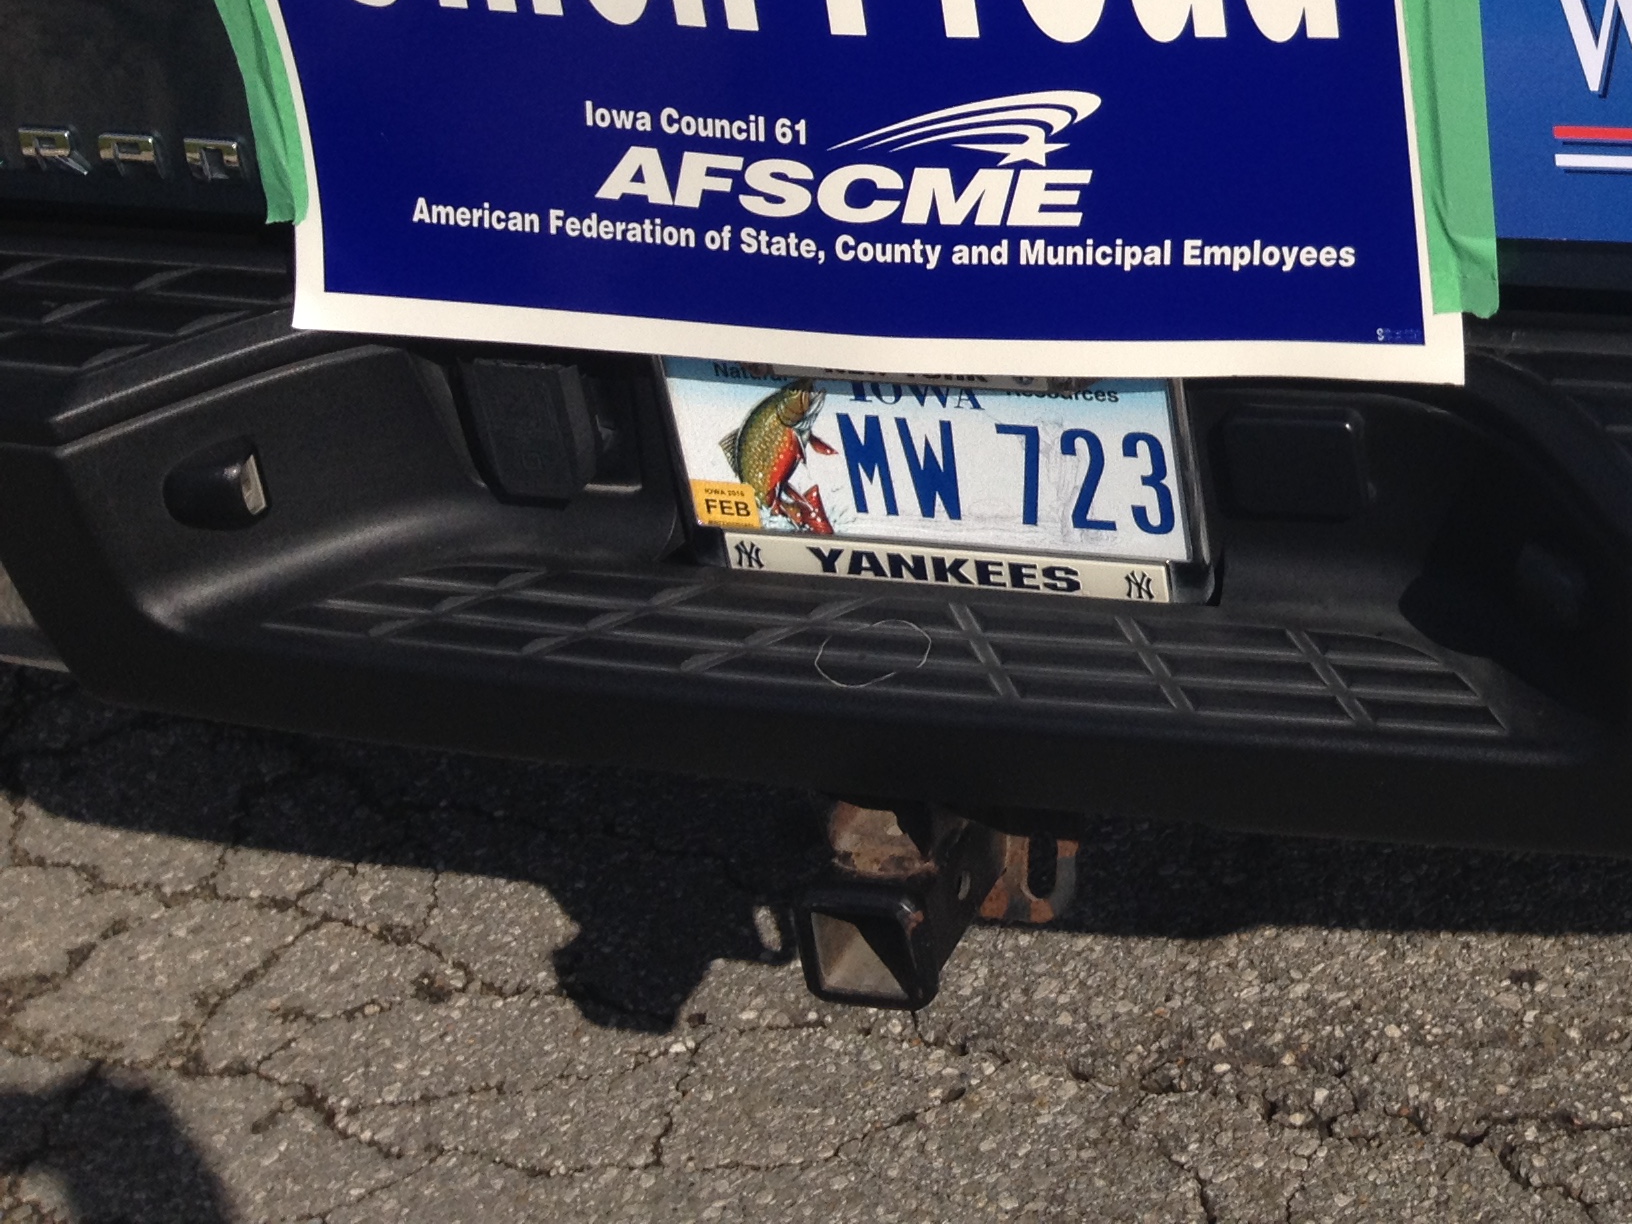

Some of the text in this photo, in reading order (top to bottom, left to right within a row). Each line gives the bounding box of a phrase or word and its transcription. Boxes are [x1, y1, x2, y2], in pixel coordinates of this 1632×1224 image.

[585, 100, 807, 145] Iowa Council 61
[595, 155, 1093, 227] AFSCME
[412, 197, 1356, 272] American Federation of State, County and Municipal Employees
[836, 412, 1177, 536] MW 723
[705, 498, 751, 517] FEB
[806, 546, 1082, 593] YANKEES
